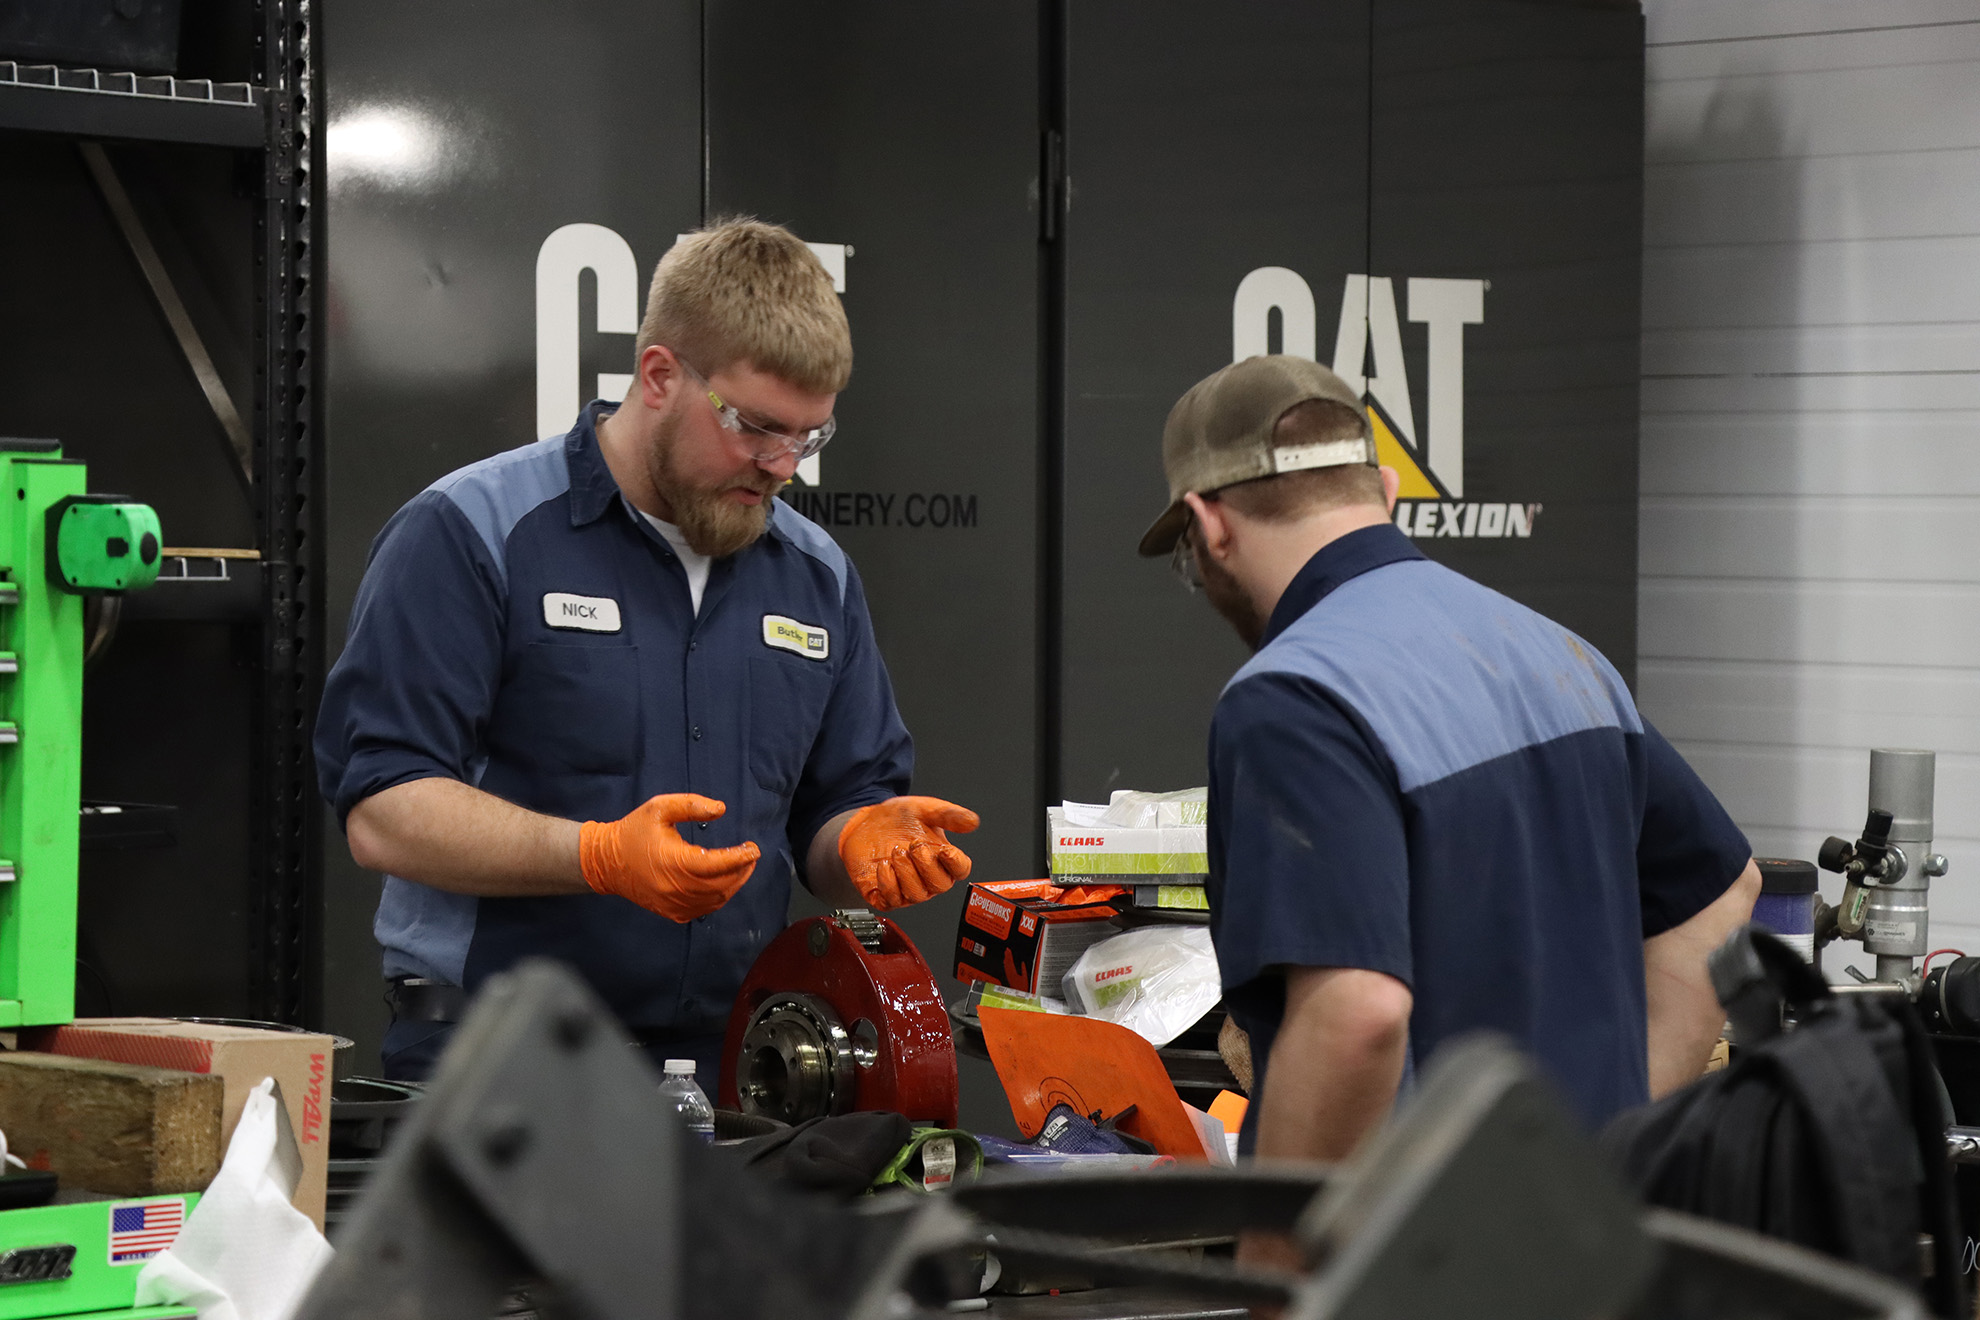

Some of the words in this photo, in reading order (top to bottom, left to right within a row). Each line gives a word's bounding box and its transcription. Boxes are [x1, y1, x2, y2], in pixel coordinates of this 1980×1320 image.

[1396, 503, 1536, 538] LEXION
[562, 602, 598, 620] NICK
[808, 637, 823, 648] CAT
[1059, 837, 1105, 846] CLAAS
[1058, 875, 1094, 883] ORIGINAL
[1020, 914, 1035, 932] XXL
[1095, 965, 1133, 982] CLAAS
